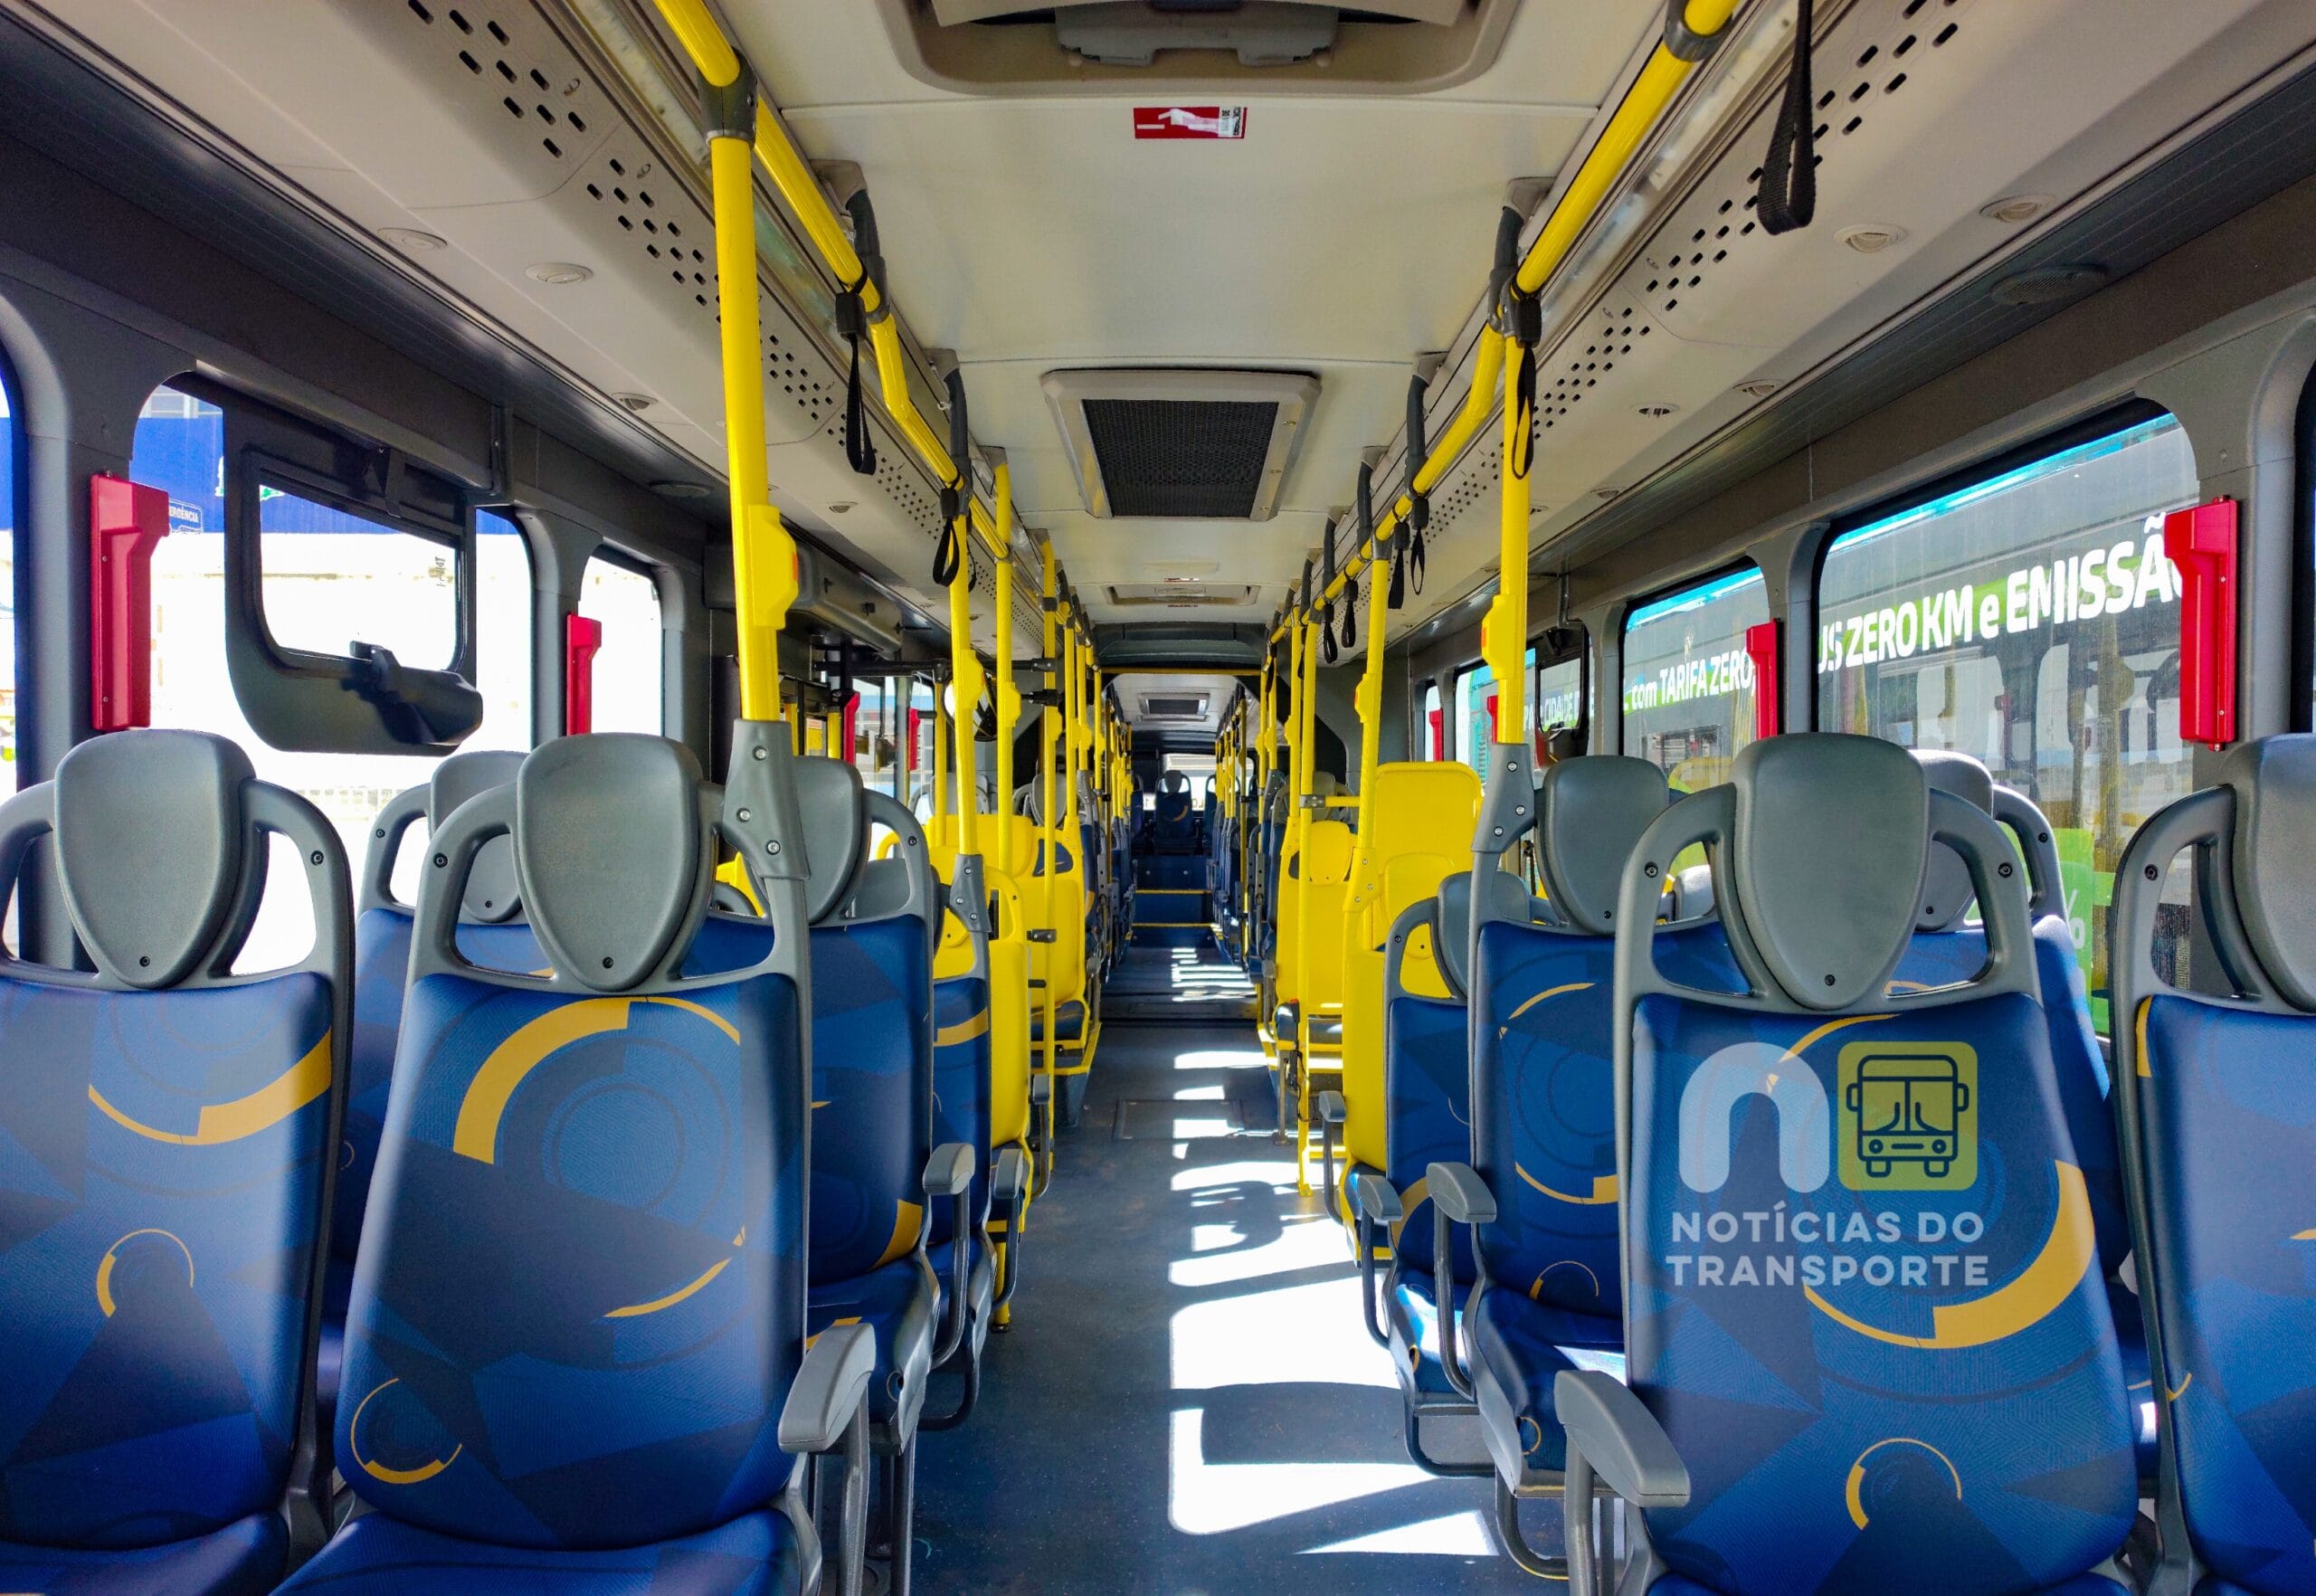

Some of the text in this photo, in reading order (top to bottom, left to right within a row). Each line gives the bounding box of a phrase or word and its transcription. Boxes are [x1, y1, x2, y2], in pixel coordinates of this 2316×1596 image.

[169, 505, 198, 523] ERGÊNCIA
[1632, 681, 1656, 710] com
[1659, 659, 1708, 704] TARIFA
[1846, 602, 1918, 668] ZERO
[1922, 584, 1973, 651] KM
[1979, 593, 1999, 639] e
[2006, 511, 2182, 634] EMISSÃ
